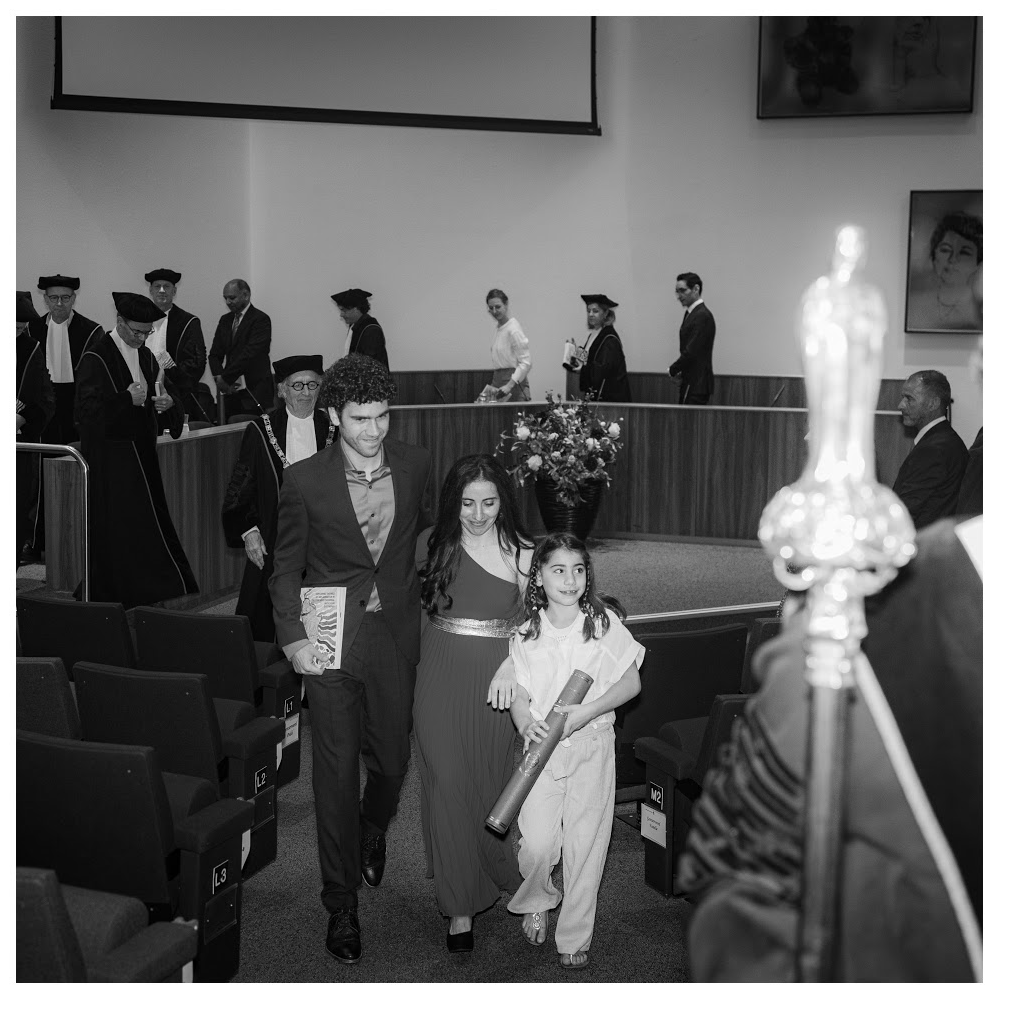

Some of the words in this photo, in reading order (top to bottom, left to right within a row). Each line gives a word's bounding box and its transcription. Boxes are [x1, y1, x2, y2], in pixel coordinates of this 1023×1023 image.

[286, 701, 293, 713] L1
[257, 772, 266, 788] L2
[650, 787, 662, 804] M2
[214, 867, 227, 887] L3
